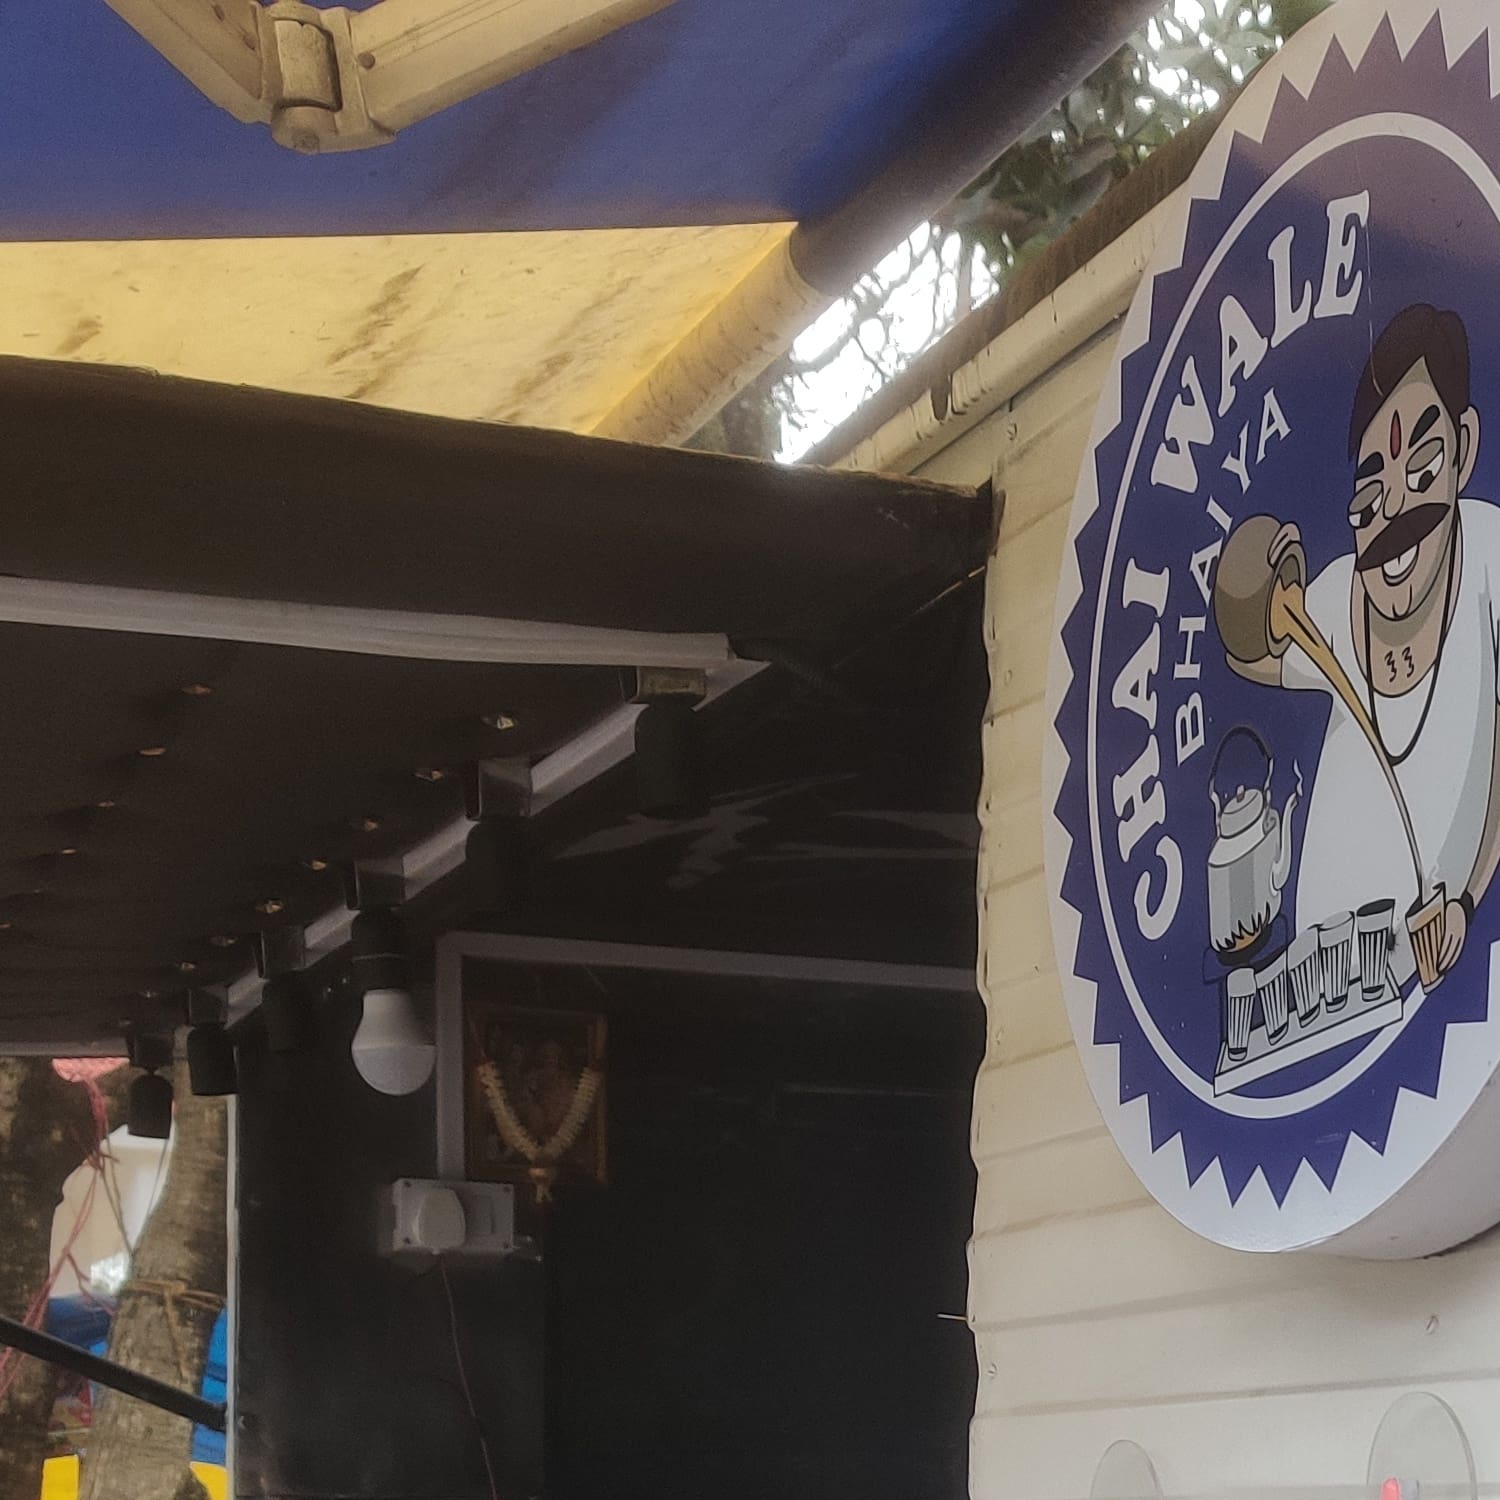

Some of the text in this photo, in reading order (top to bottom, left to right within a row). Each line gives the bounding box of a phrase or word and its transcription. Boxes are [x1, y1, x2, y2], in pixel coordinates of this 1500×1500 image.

[1113, 189, 1371, 942] CHAI WALE
[1175, 386, 1291, 766] BHAIYA
